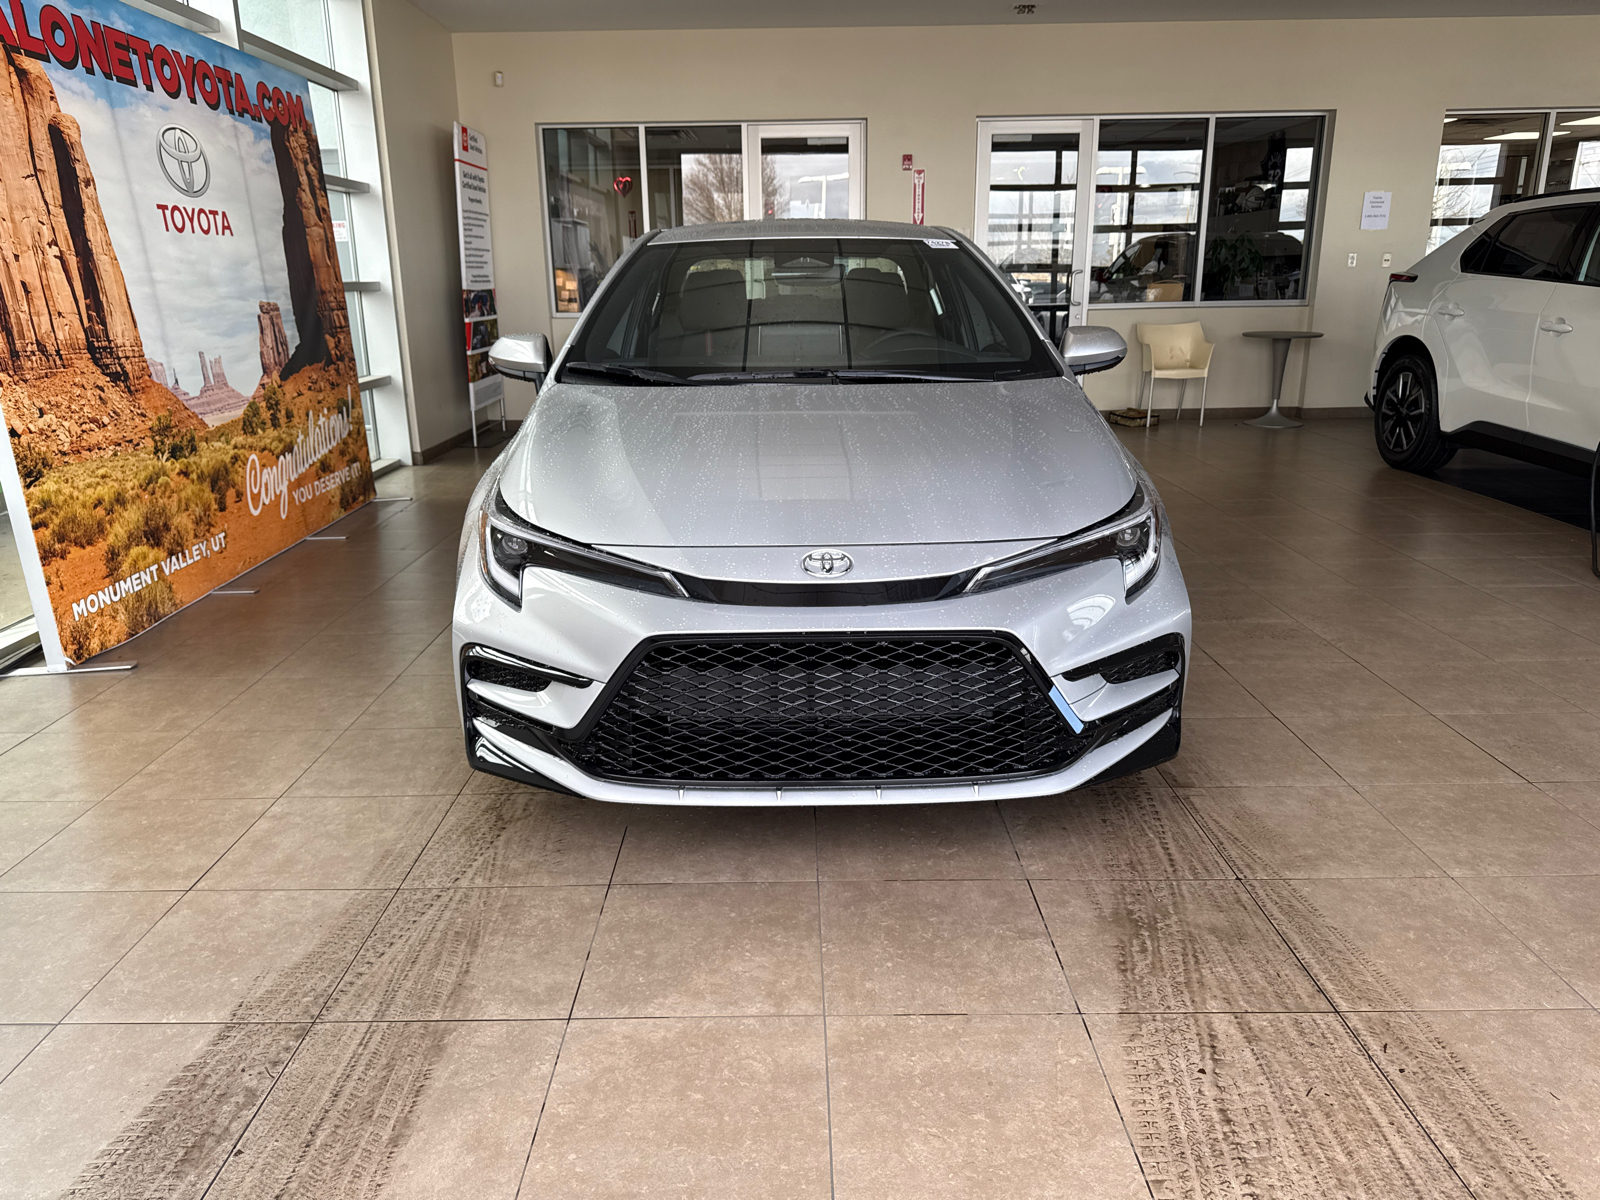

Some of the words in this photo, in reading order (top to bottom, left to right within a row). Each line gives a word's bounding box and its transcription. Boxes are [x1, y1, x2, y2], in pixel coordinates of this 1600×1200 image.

[156, 204, 234, 237] TOYOTA
[292, 483, 313, 506] YOU
[314, 466, 351, 496] DESERVE
[350, 461, 362, 479] IT!
[71, 564, 158, 622] MONUMENT
[160, 540, 211, 576] VALLEY,
[210, 531, 226, 552] UT
